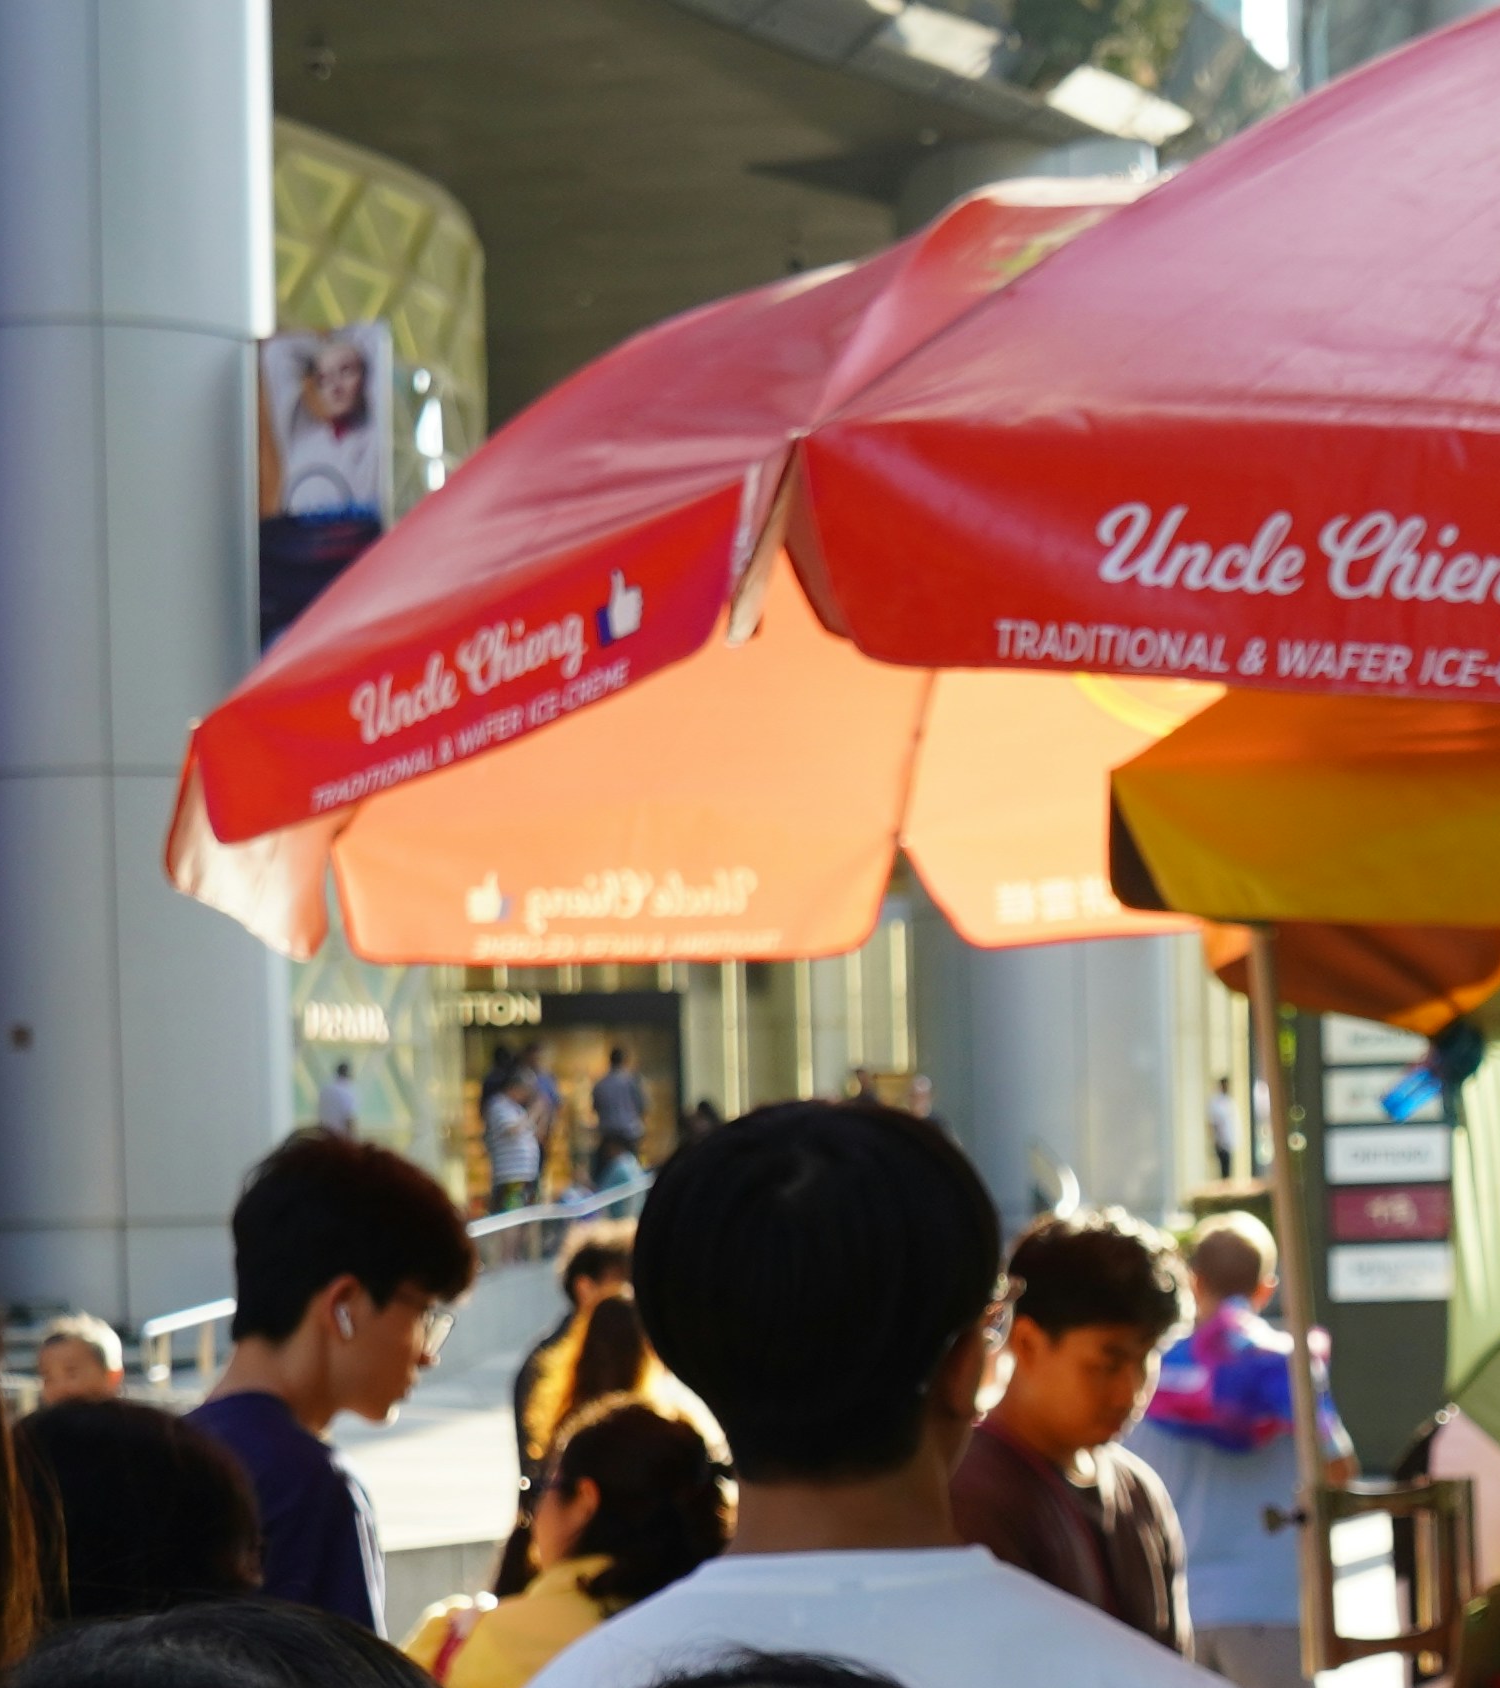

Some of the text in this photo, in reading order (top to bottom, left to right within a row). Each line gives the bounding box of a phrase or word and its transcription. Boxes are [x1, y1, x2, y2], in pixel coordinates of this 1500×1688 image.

[1096, 503, 1304, 595] Uncle
[350, 612, 590, 744] Uncle Chieng
[994, 618, 1229, 675] TRADITIONAL
[1237, 637, 1267, 677] &
[1278, 639, 1412, 686] WAFER
[311, 744, 436, 815] TRADITIONAL
[438, 734, 456, 765] &
[455, 703, 525, 758] WAFER
